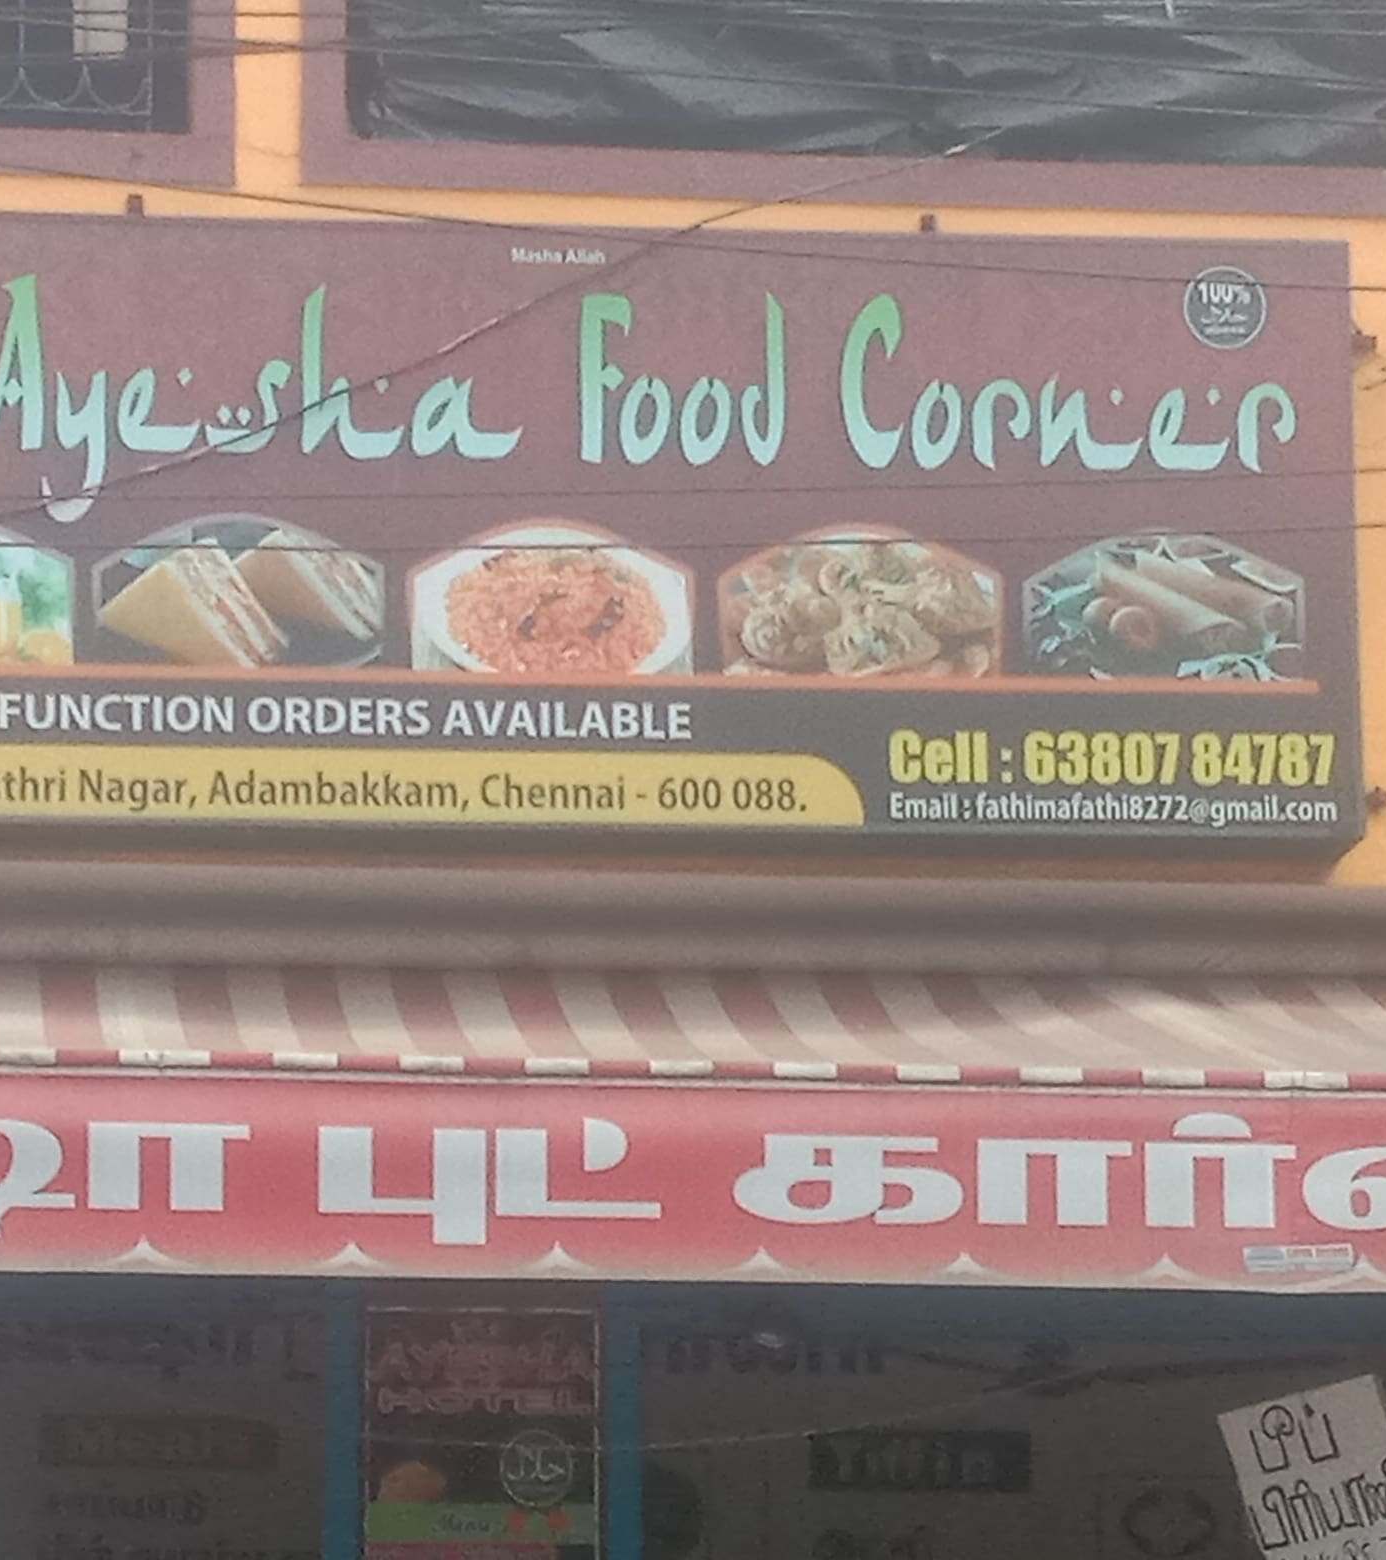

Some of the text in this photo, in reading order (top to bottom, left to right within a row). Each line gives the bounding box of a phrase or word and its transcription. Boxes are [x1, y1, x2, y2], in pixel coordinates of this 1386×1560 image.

[579, 291, 787, 467] Food
[841, 294, 1298, 475] Corner
[247, 696, 432, 737] ORDERS
[442, 700, 693, 741] AVAILABLE
[889, 729, 989, 785] Cell
[1023, 730, 1181, 786] 63807
[1191, 732, 1336, 787] 84787
[78, 768, 198, 812] Nagar,
[207, 768, 470, 813] Adambakkam,
[480, 773, 625, 811] Chennai
[657, 777, 721, 812] 600
[732, 778, 808, 813] 088.
[318, 1117, 661, 1246] புட்
